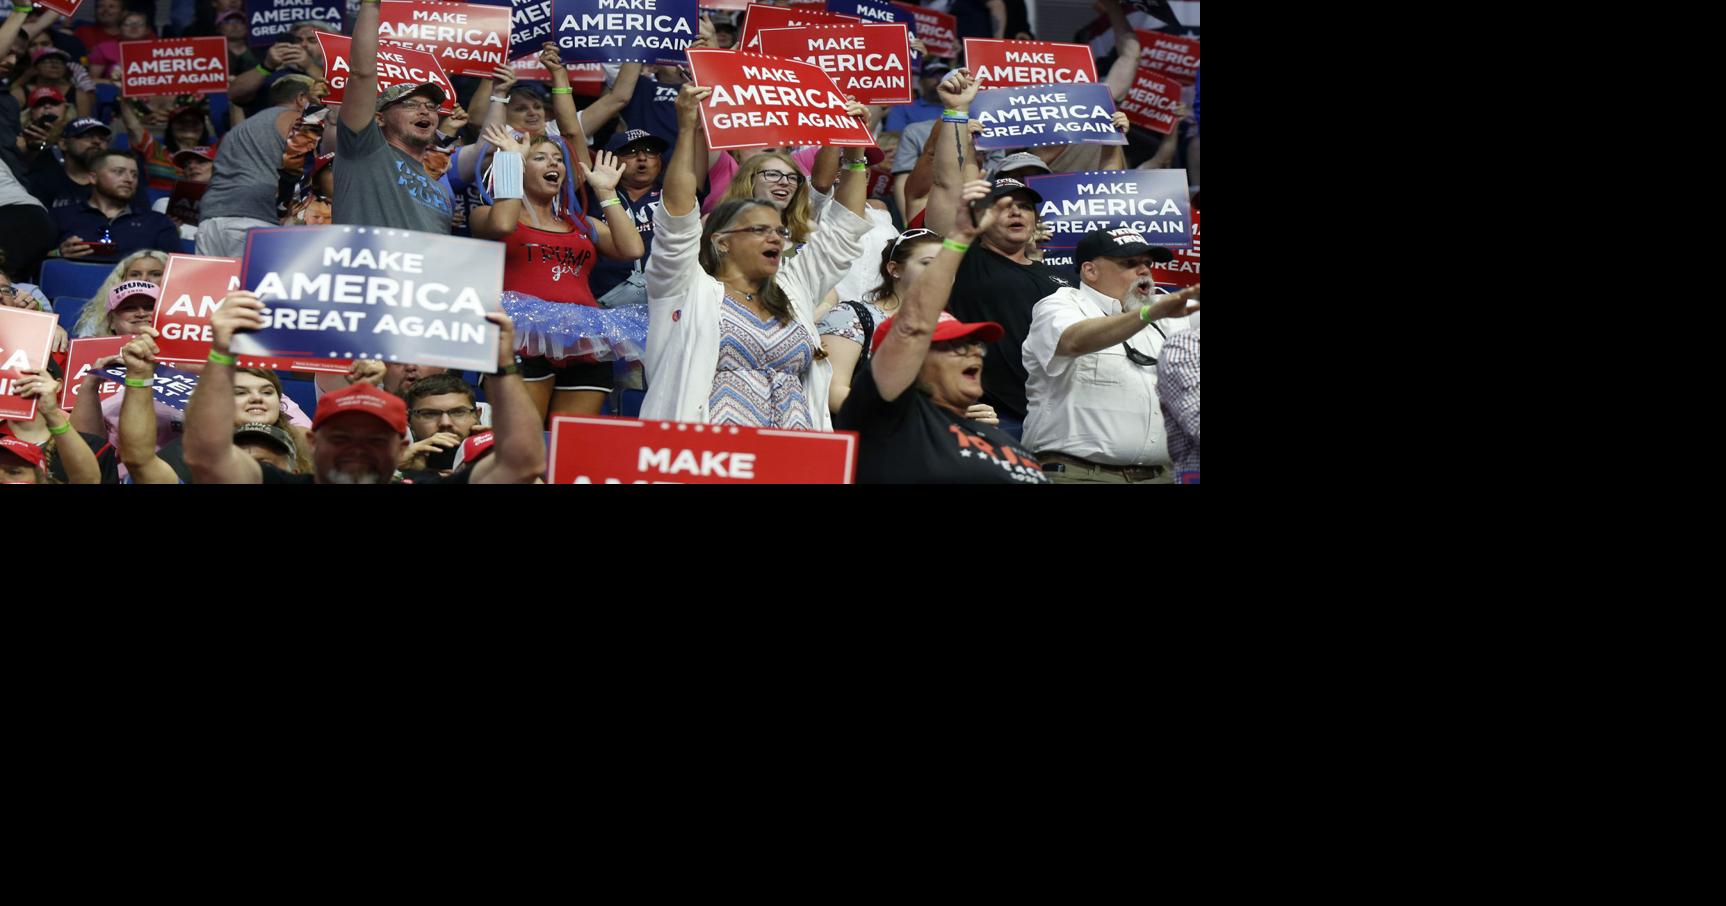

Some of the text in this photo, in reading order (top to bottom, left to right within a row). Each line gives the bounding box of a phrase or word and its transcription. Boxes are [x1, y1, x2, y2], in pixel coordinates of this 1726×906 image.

[599, 0, 656, 10] MAKE
[857, 4, 895, 22] MAKE
[251, 7, 341, 24] AMERICA
[413, 10, 467, 24] MAKE
[559, 13, 692, 34] AMERICA
[378, 21, 503, 48] AMERICA
[559, 35, 692, 51] GREAT AGAIN
[152, 46, 194, 57] MAKE
[807, 37, 866, 51] MAKE
[441, 46, 501, 64] AGAIN
[1005, 51, 1056, 64] MAKE
[127, 57, 224, 75] AMERICA
[742, 65, 800, 83] MAKE
[975, 65, 1091, 84] AMERICA
[127, 73, 225, 86] GREAT AGAIN
[847, 76, 905, 89] AGAIN
[709, 85, 848, 110] AMERICA
[1009, 93, 1068, 105] MAKE
[713, 112, 859, 129] GREAT AGAIN
[978, 105, 1111, 124] AMERICA
[981, 122, 1116, 138] GREAT AGAIN
[1077, 182, 1139, 195] MAKE
[1040, 198, 1182, 216] AMERICA
[322, 247, 425, 273] MAKE
[521, 243, 592, 266] TRUMP
[113, 281, 155, 294] TRUMP
[254, 271, 486, 316] AMERICA
[257, 308, 485, 344] GREAT AGAIN
[637, 446, 757, 479] MAKE
